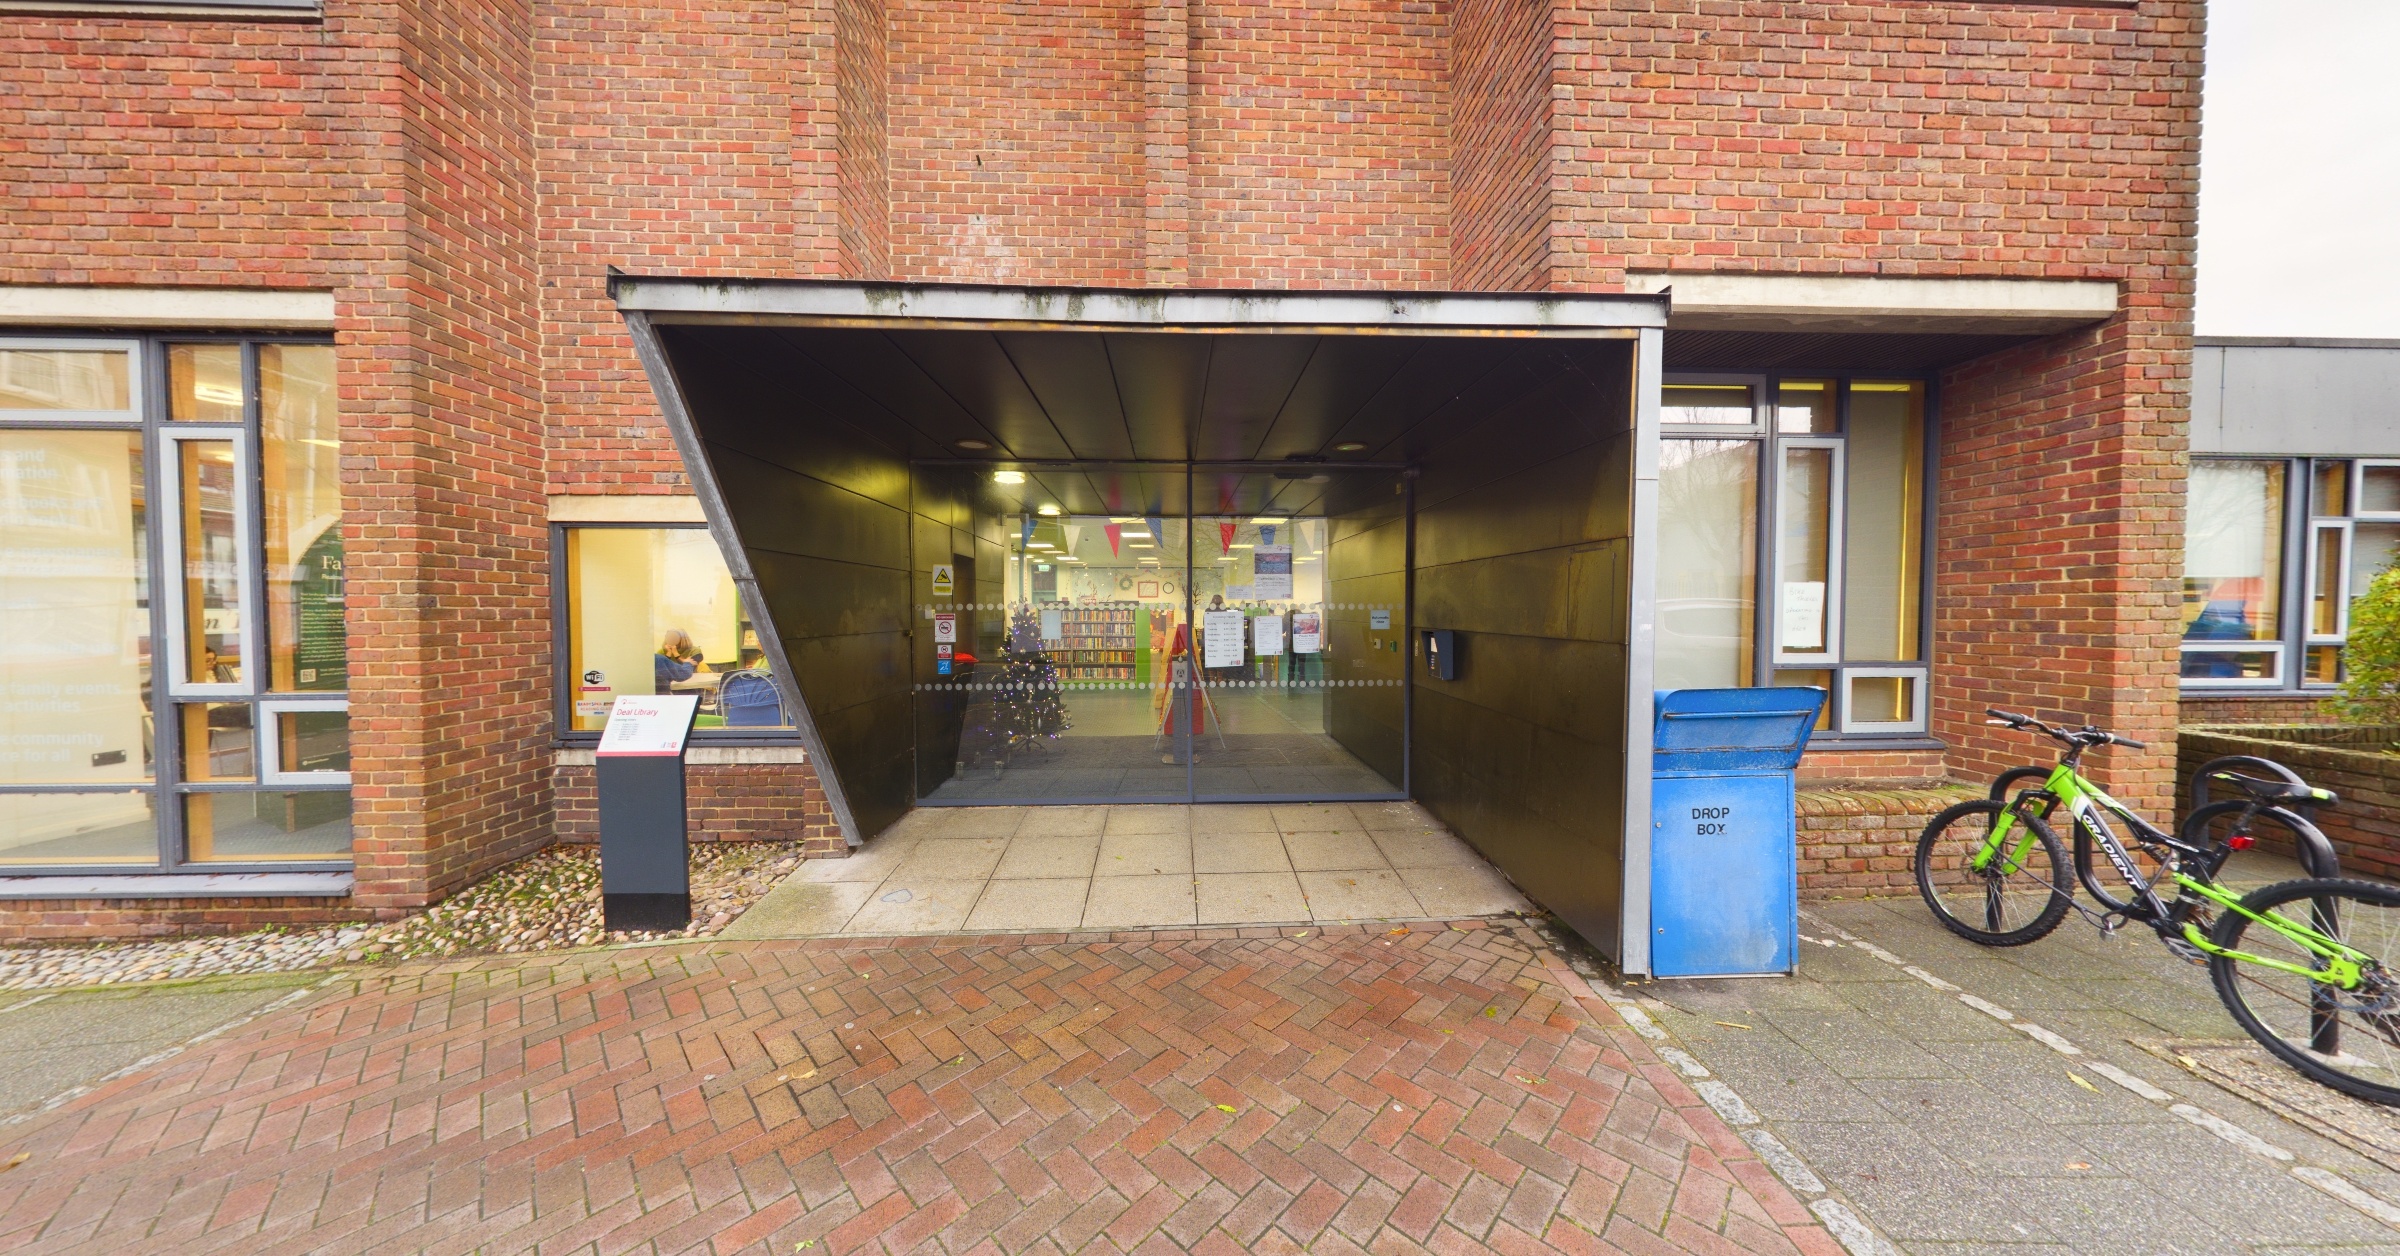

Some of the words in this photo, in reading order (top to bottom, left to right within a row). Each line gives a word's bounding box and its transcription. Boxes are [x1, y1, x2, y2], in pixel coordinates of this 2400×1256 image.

[321, 555, 342, 571] Fa
[10, 682, 61, 698] family
[64, 684, 122, 696] events
[5, 699, 81, 713] activities
[616, 708, 633, 716] Deal
[633, 708, 659, 718] Library
[12, 732, 104, 748] community
[24, 748, 47, 762] for
[51, 748, 71, 762] all
[1692, 807, 1730, 819] DROP
[1697, 823, 1728, 835] BOX
[2082, 814, 2142, 890] GRADIENT
